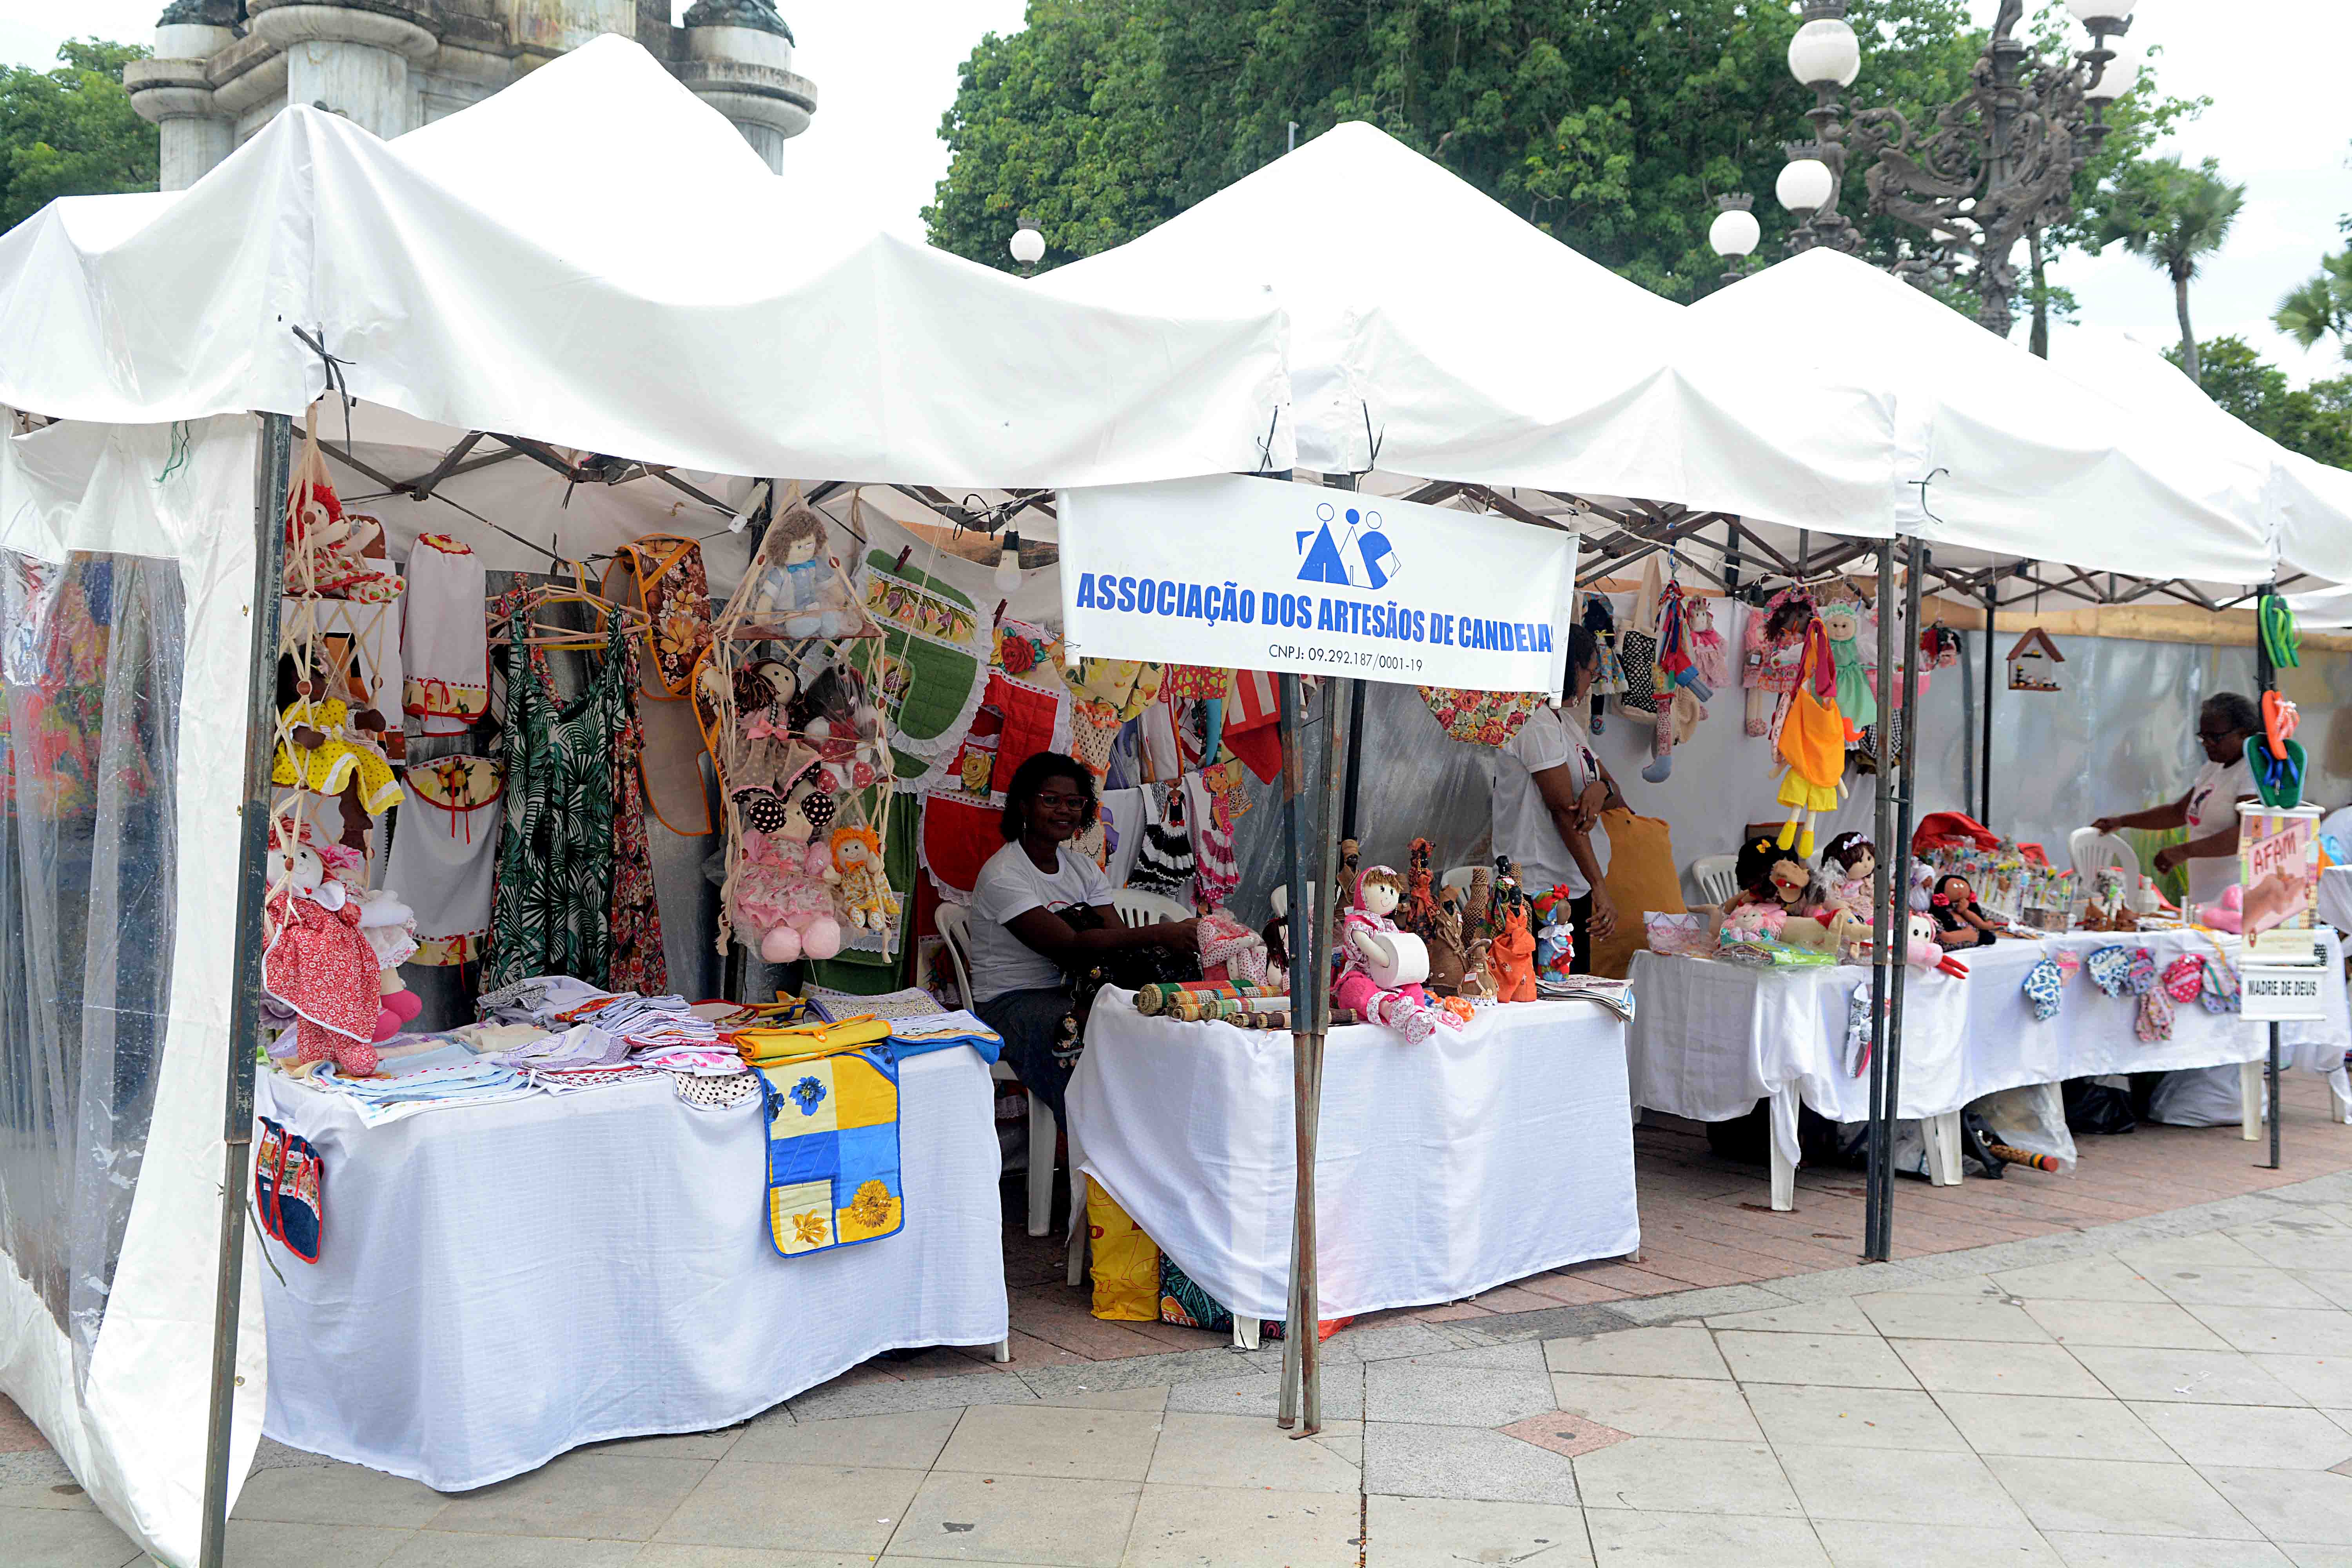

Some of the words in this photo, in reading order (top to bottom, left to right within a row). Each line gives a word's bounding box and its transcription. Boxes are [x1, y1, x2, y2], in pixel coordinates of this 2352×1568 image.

[1076, 572, 1255, 628] ASSOCIAÇÃO
[1261, 591, 1312, 630] DOS
[1316, 597, 1425, 643] ARTESÃOS
[1429, 612, 1454, 646] DE
[1458, 616, 1554, 654] CANDEIA
[1269, 644, 1304, 660] CNPJ:
[1308, 647, 1423, 672] 09.292.187/0001-19
[2254, 831, 2296, 875] AFAM
[2248, 980, 2278, 996] MADRE
[2281, 980, 2292, 996] DE
[2295, 980, 2317, 996] DEUS
